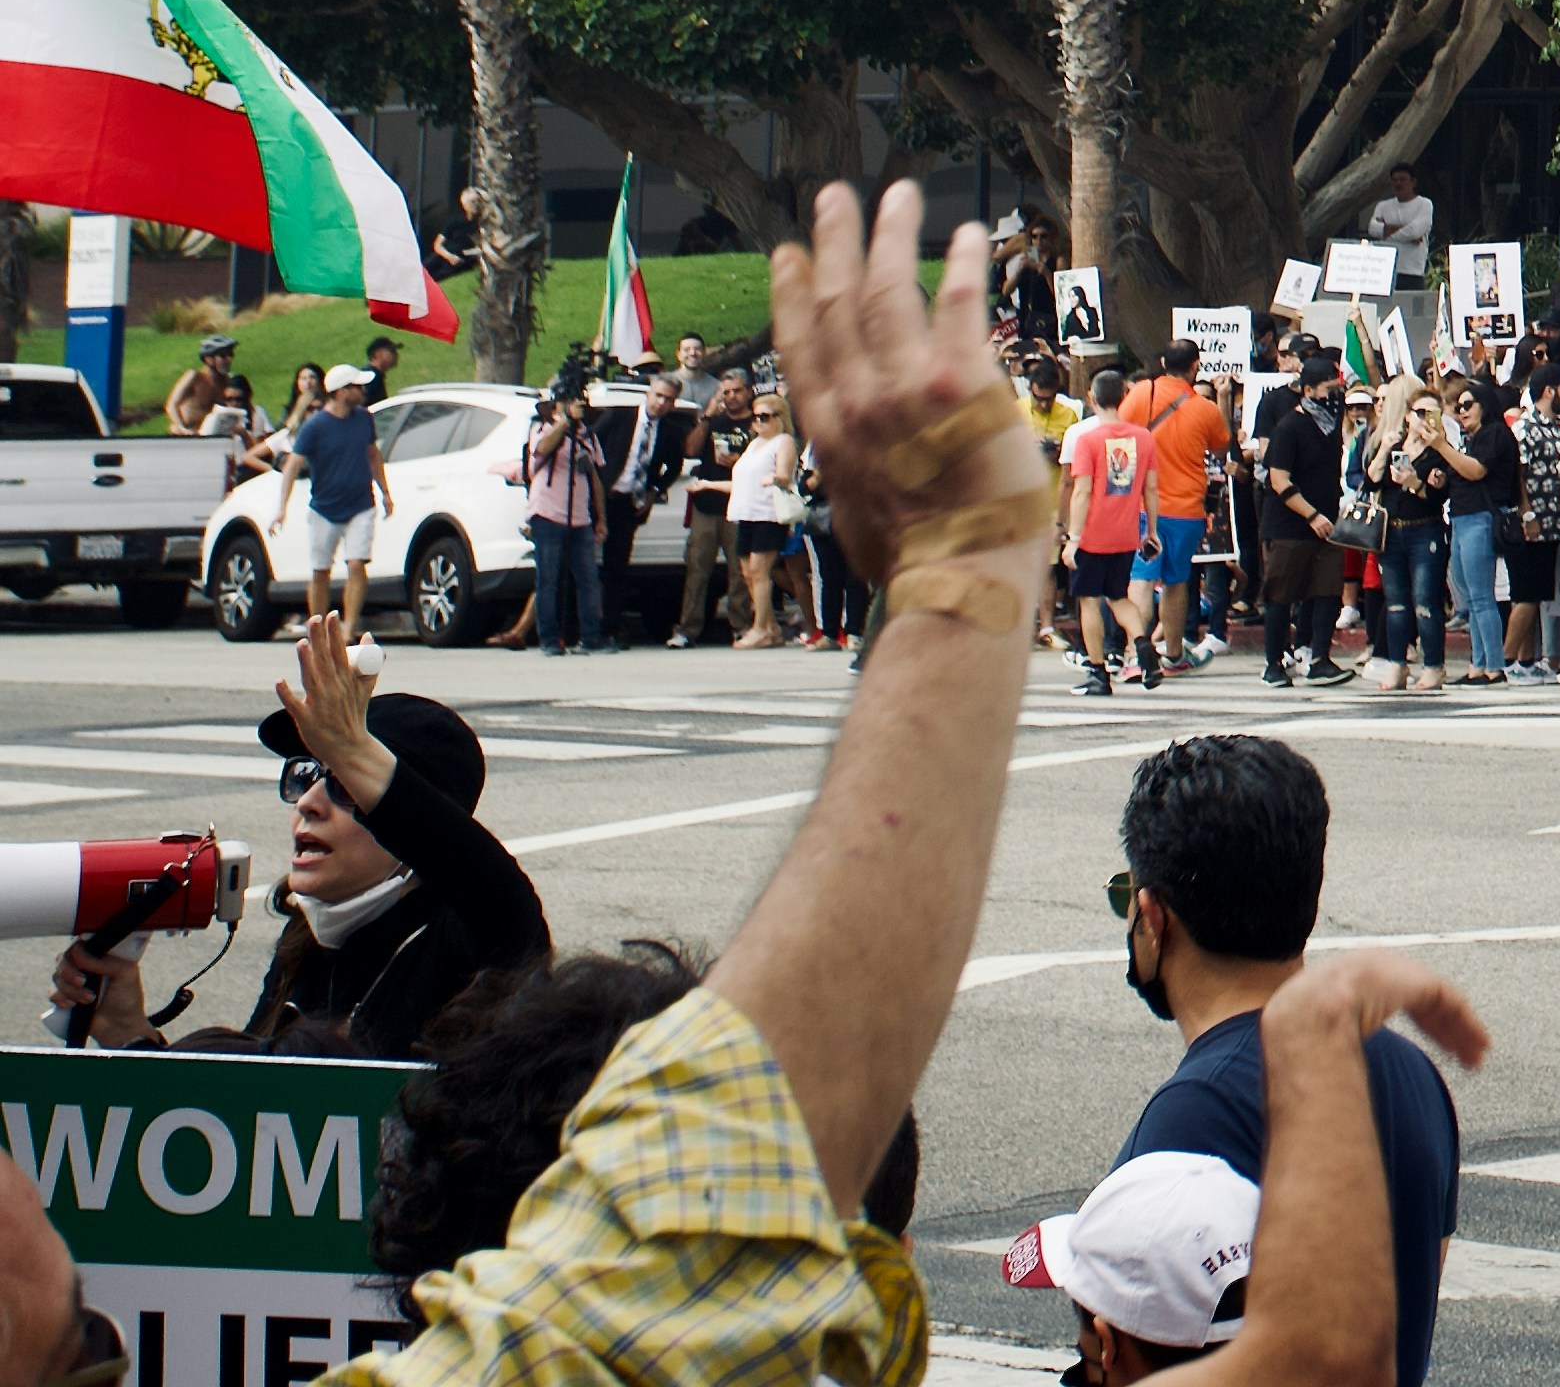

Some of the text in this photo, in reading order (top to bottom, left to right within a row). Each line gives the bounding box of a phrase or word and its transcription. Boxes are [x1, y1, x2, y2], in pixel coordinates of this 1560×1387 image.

[1186, 318, 1239, 334] Woman
[1199, 339, 1227, 353] Life
[1196, 360, 1244, 375] eedom
[1201, 1241, 1251, 1277] HARV
